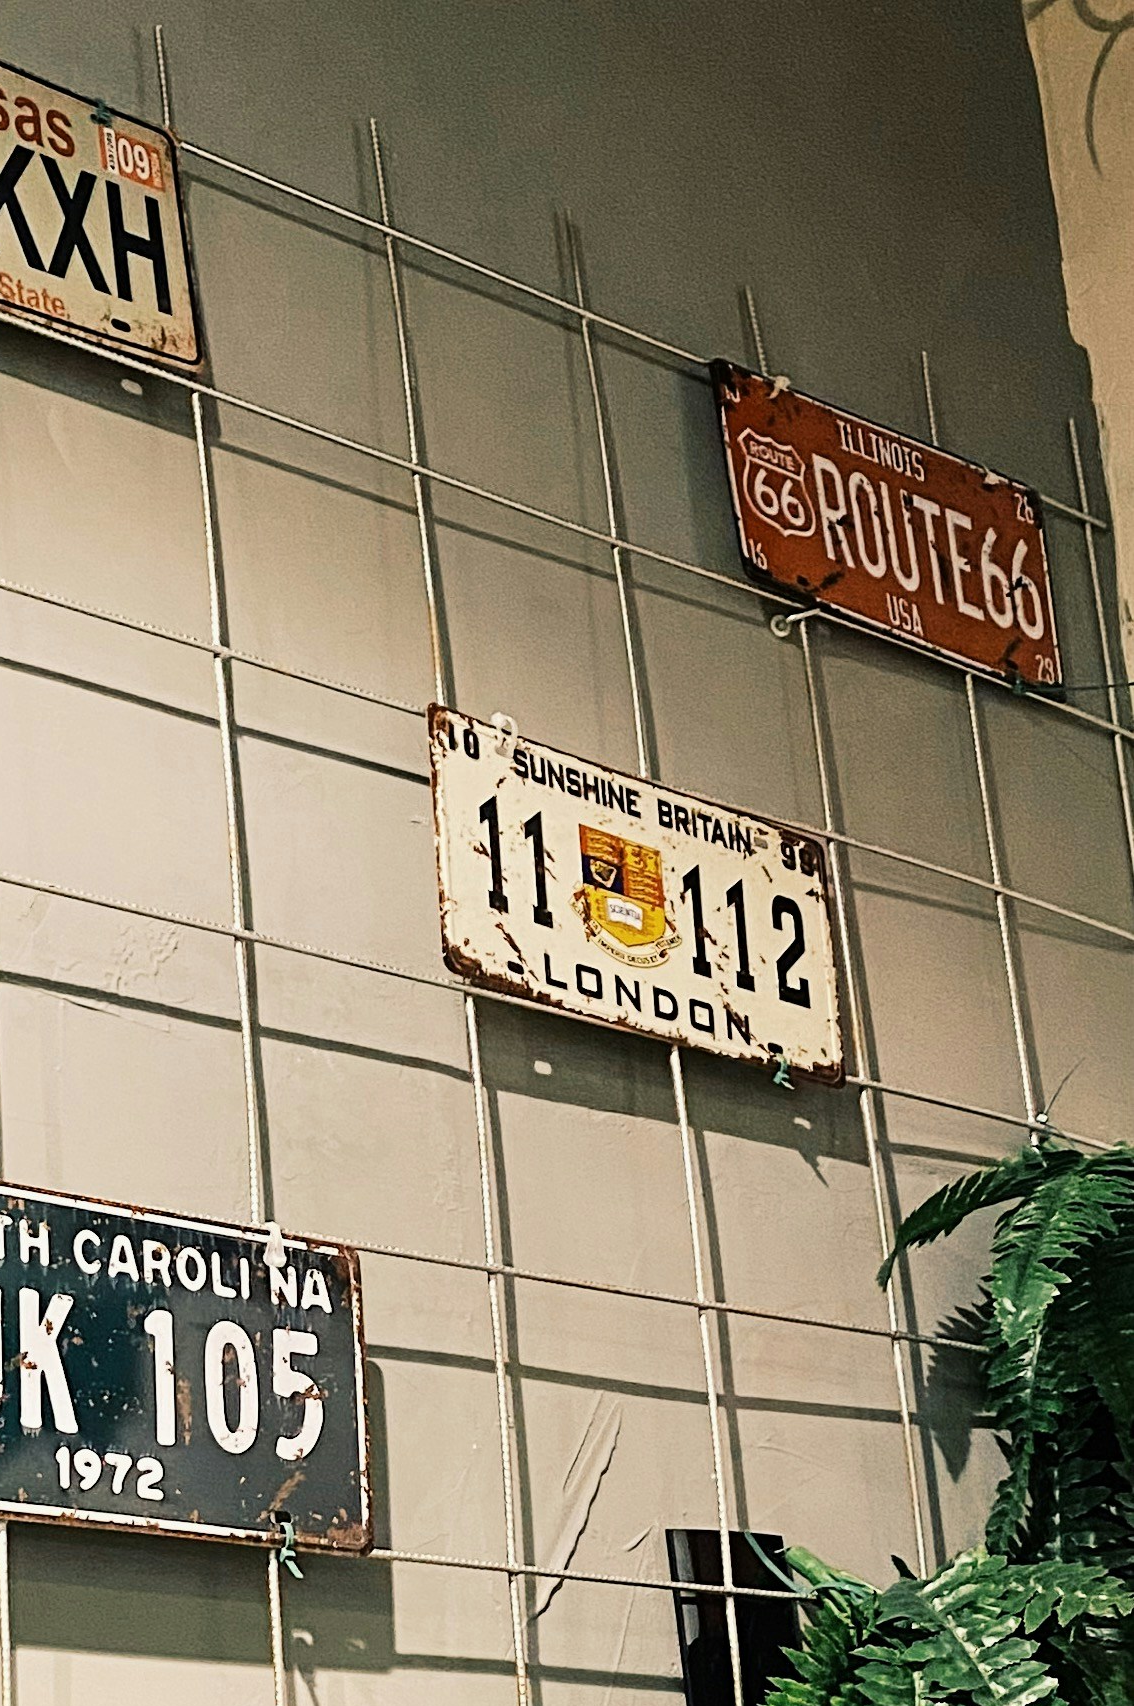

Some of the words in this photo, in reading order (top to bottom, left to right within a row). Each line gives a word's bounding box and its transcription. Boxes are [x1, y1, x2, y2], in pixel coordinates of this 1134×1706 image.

[118, 137, 150, 180] 09
[750, 440, 796, 472] ROUTE
[836, 419, 925, 483] ILLINOIS
[754, 468, 806, 527] 66
[886, 592, 925, 637] USA
[513, 748, 643, 819] SUNSHINE
[657, 798, 753, 855] BRITAIN
[479, 795, 554, 930] 11
[682, 864, 812, 1009] 112
[544, 952, 754, 1046] LONDON
[144, 1309, 325, 1461] 105
[55, 1445, 166, 1501] 1972
